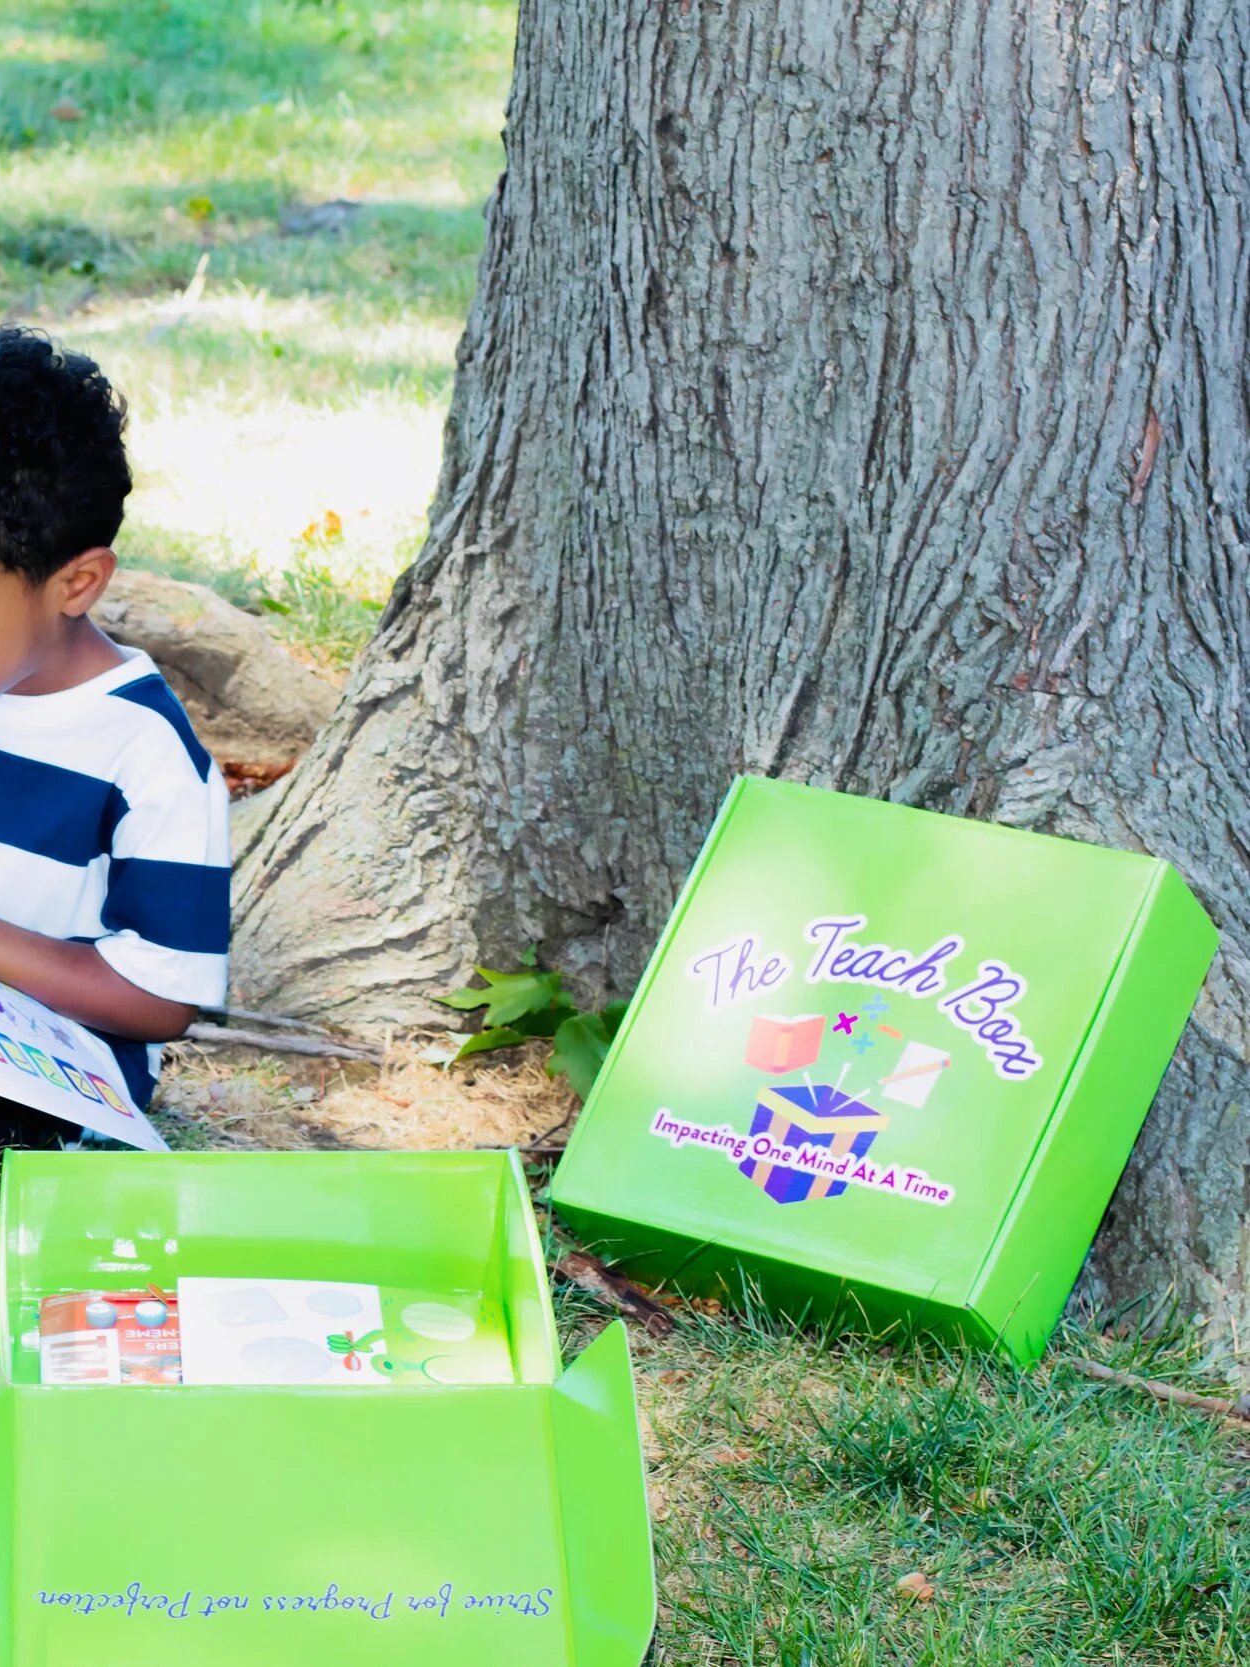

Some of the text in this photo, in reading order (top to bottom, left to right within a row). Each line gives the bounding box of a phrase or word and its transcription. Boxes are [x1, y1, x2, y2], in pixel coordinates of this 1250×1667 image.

[693, 920, 1036, 1074] The Teach Box
[654, 1112, 949, 1201] Impacting One Mind At A Time
[145, 1341, 180, 1351] ERS
[38, 1583, 553, 1619] Strive for Progress not Perfection
